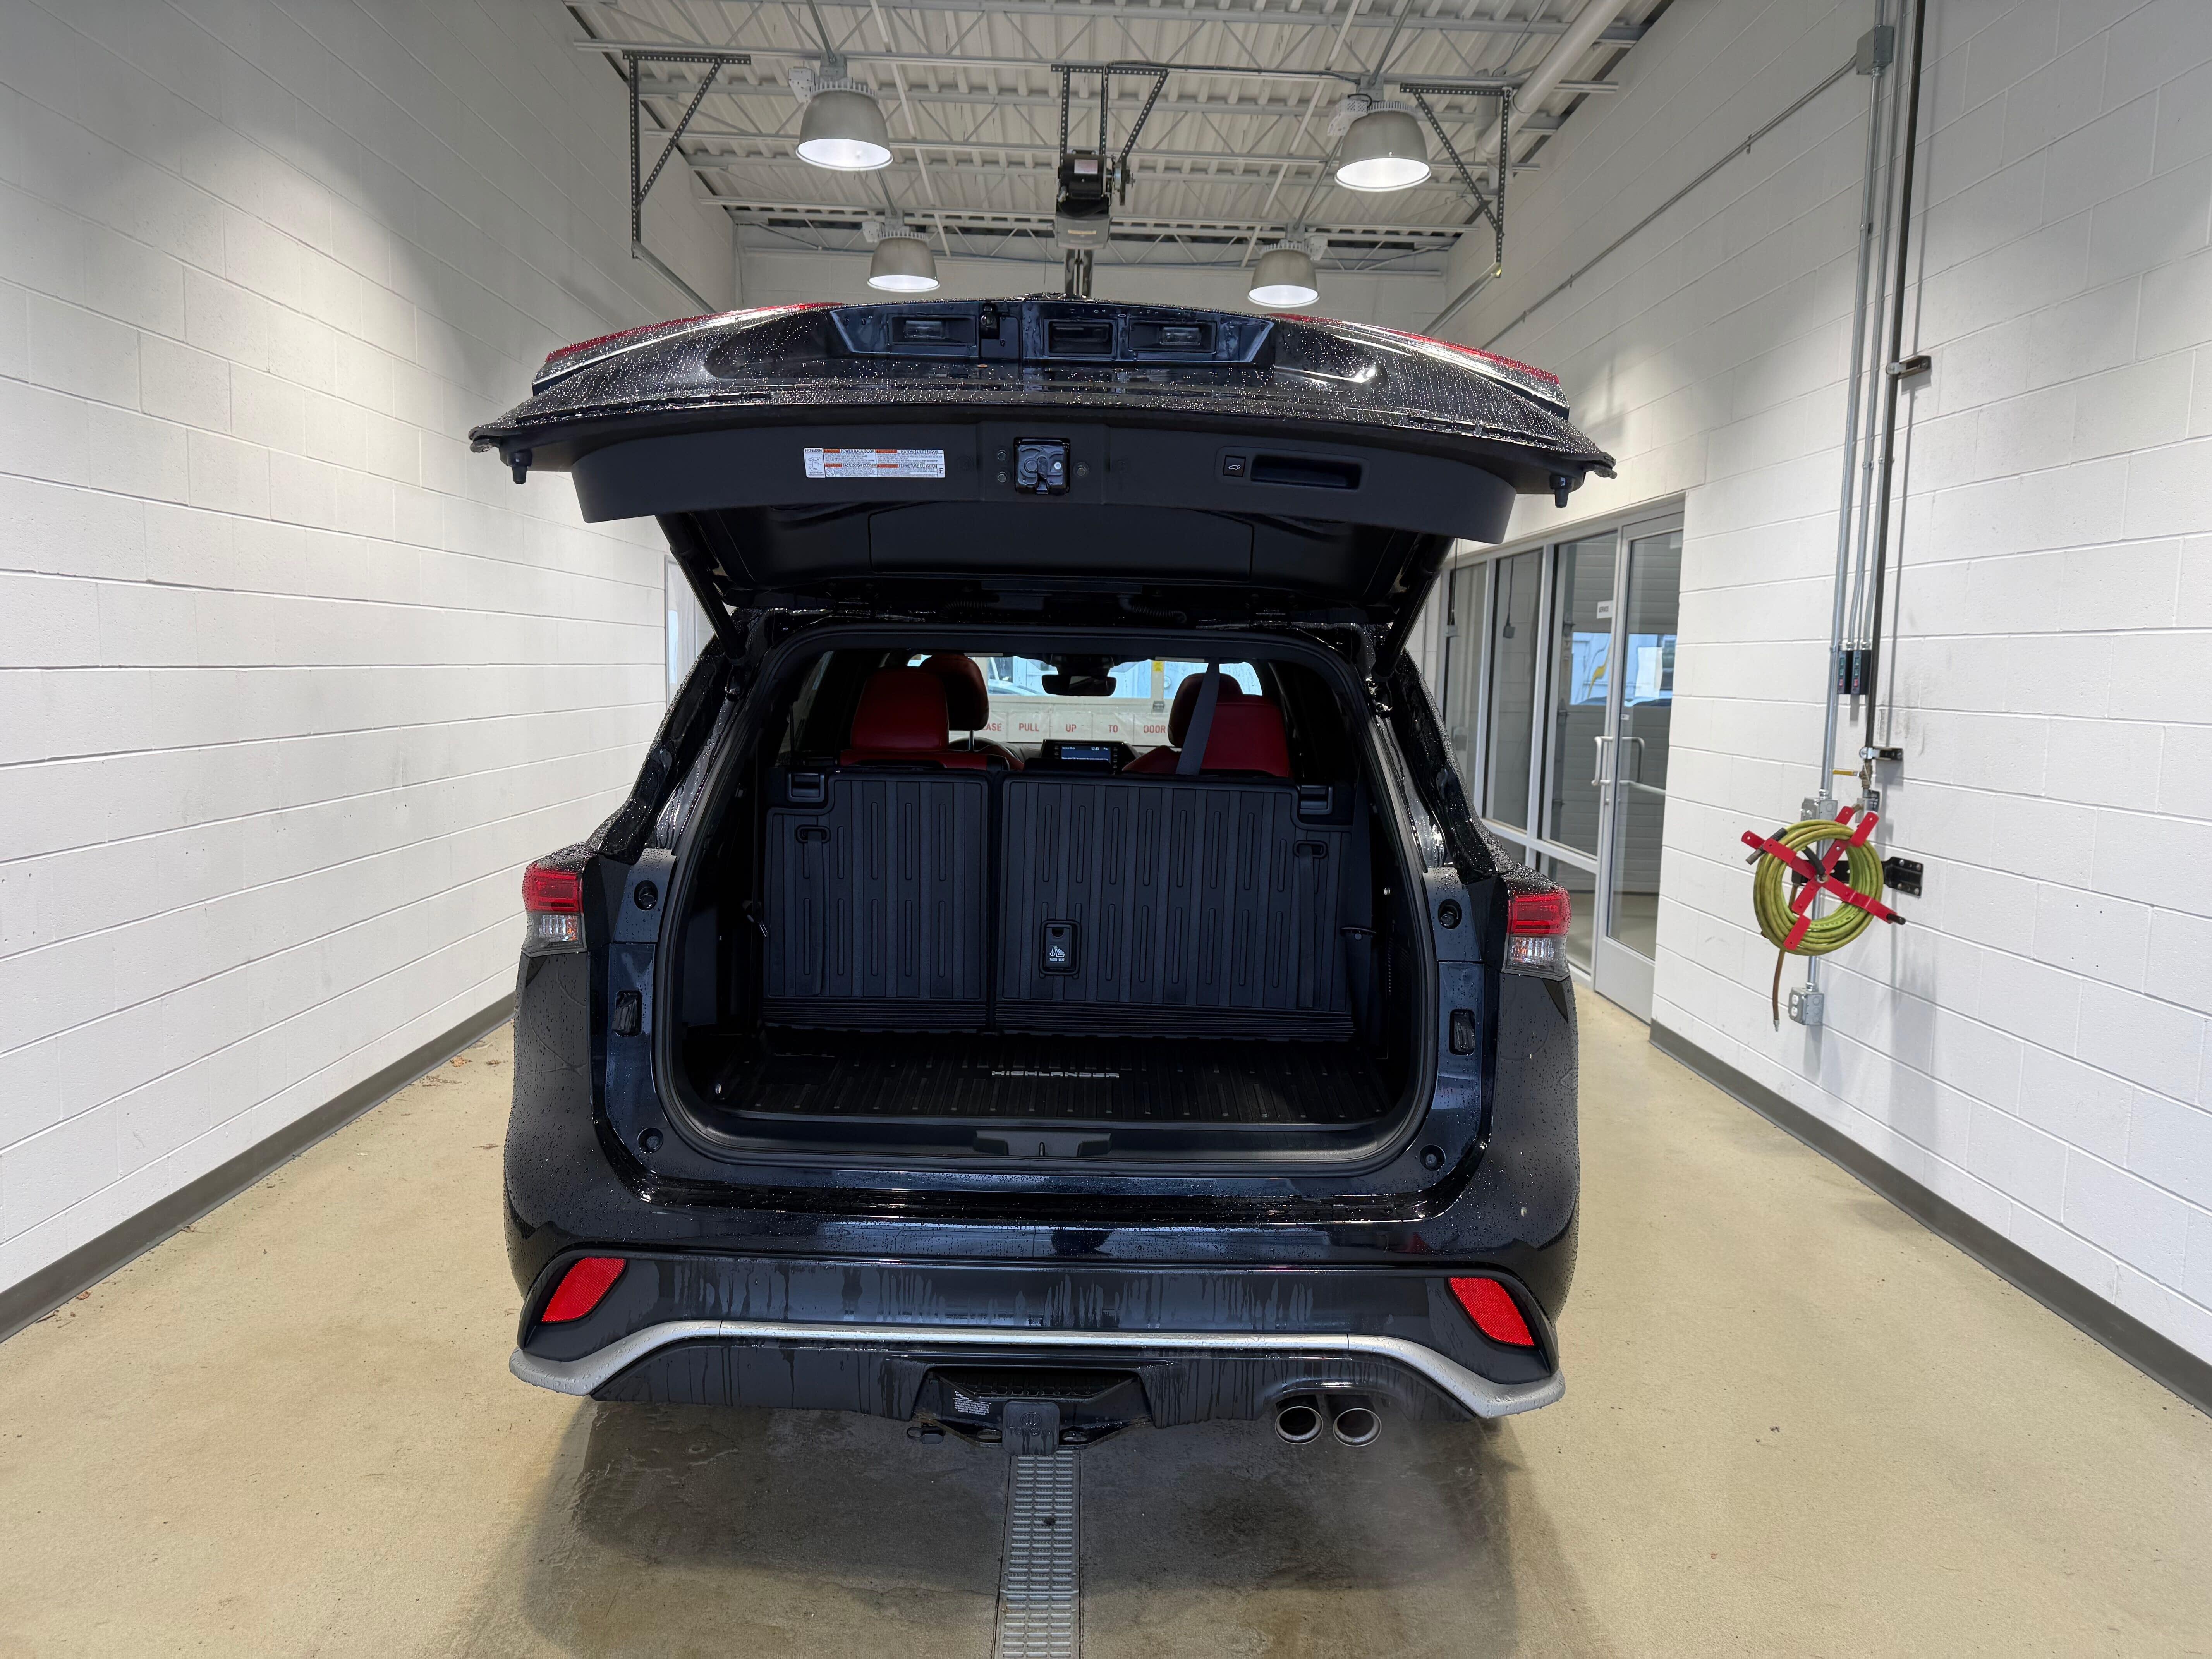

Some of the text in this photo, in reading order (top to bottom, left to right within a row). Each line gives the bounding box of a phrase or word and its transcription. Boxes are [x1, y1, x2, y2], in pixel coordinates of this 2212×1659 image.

[1019, 723, 1039, 731] PULL
[1066, 724, 1077, 732] UP
[1109, 725, 1118, 733] TO
[1144, 725, 1166, 733] DOOR
